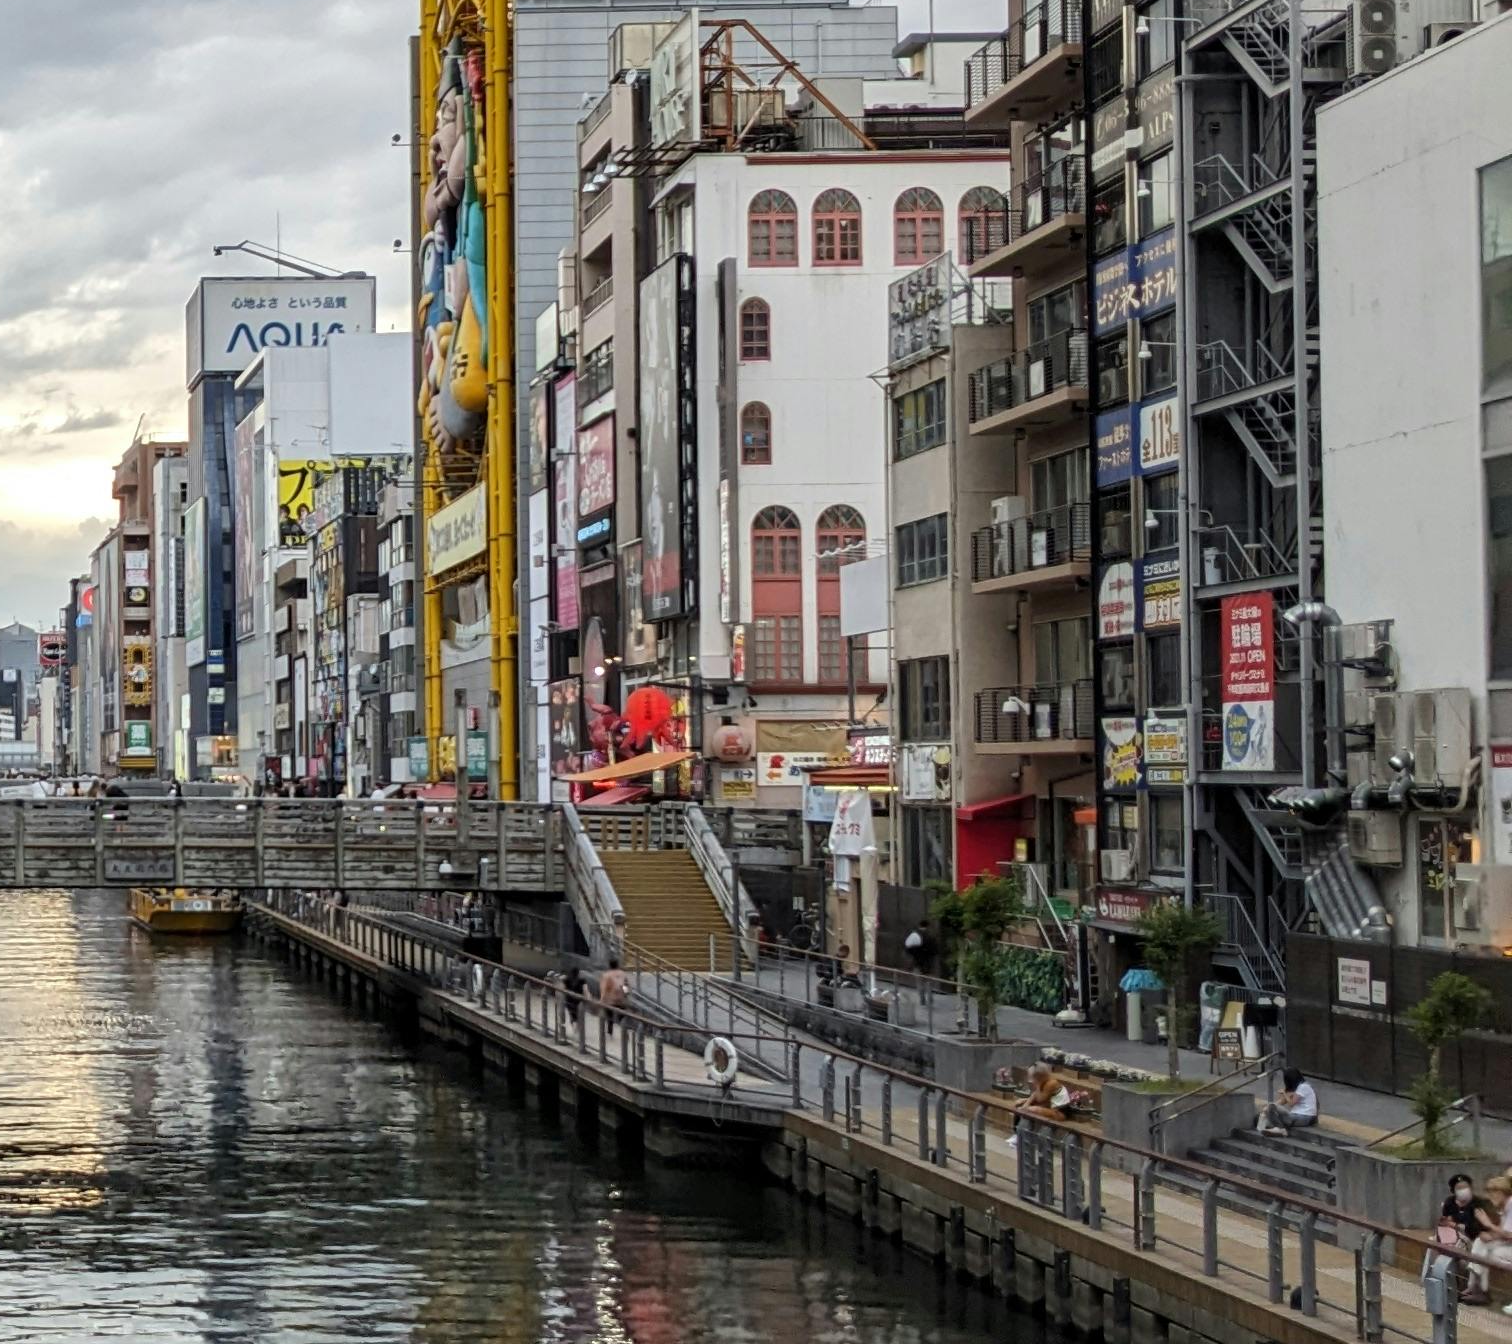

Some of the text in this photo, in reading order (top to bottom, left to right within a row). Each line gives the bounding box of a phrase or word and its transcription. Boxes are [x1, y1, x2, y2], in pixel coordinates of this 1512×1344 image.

[231, 296, 349, 310] 心地よさ という品質
